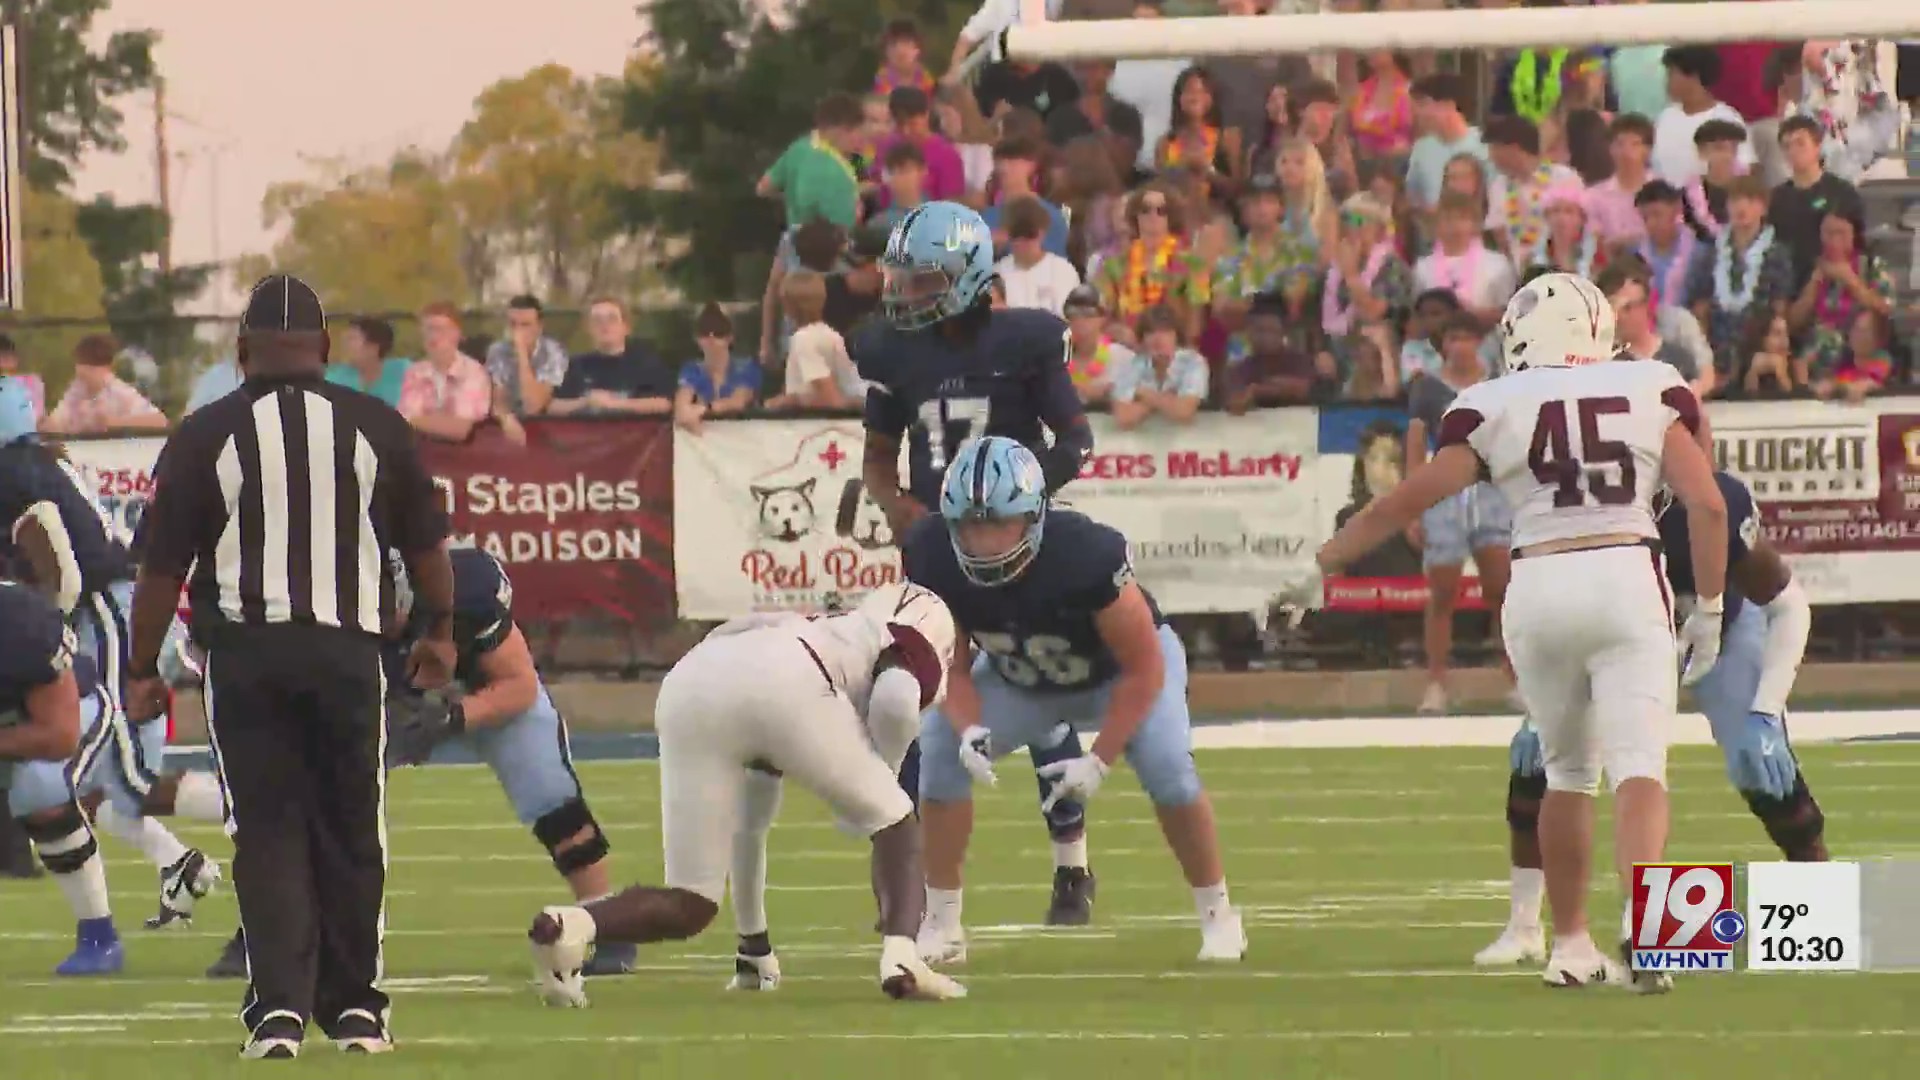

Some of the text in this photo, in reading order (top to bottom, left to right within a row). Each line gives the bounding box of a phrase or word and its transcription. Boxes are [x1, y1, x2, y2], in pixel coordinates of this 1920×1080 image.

[917, 397, 990, 470] 17
[1528, 396, 1637, 508] 45
[1078, 450, 1302, 481] DERS McLarty
[466, 472, 641, 524] Staples
[741, 546, 904, 593] Red Bar
